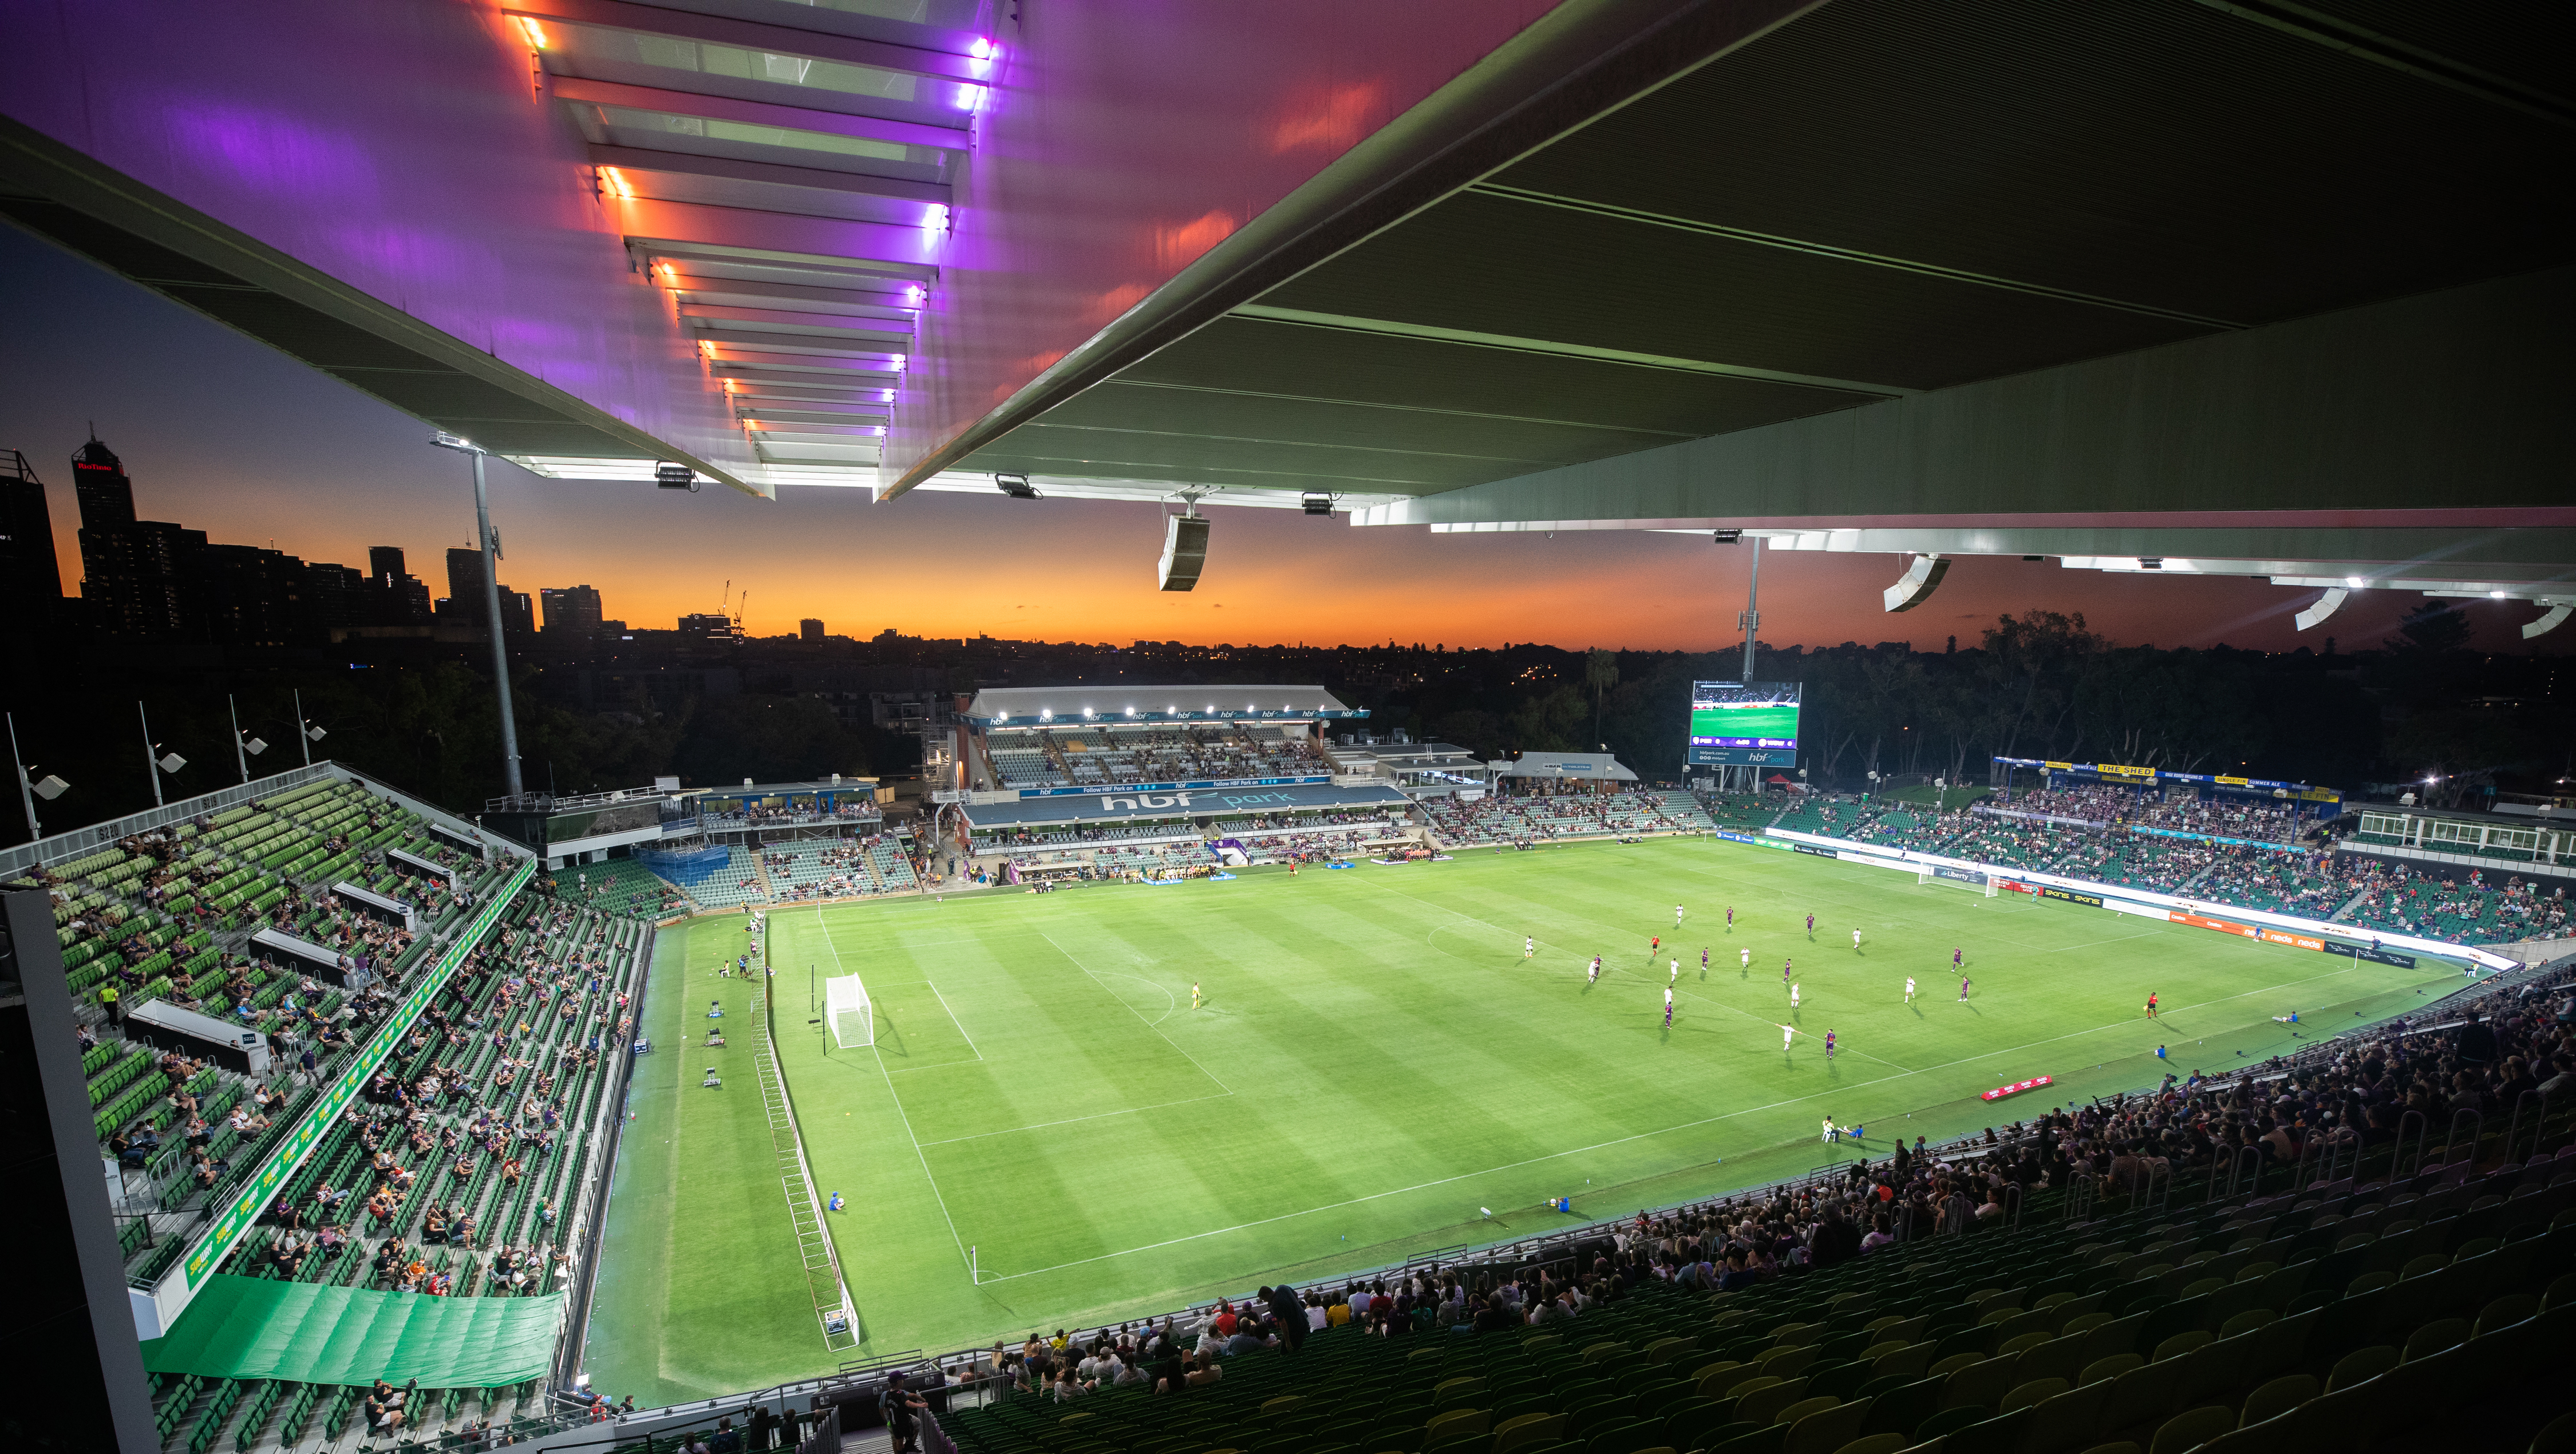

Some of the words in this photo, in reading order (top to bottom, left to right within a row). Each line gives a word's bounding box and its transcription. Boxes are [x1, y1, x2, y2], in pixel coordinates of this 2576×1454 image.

[1749, 753, 1769, 761] hbf
[2124, 767, 2151, 775] SHED
[203, 796, 217, 809] S219
[1101, 792, 1196, 811] hbf
[1222, 792, 1297, 807] park
[99, 824, 118, 840] S220
[1947, 870, 1969, 880] Liberty
[2270, 934, 2293, 943] neds
[2298, 939, 2321, 949] neds
[318, 1099, 332, 1121] SUBWAY
[301, 1119, 315, 1143] SUBWAY
[283, 1139, 299, 1164] SUBWAY
[263, 1160, 280, 1187] SUBWAY
[240, 1186, 259, 1216] SUBWAY
[216, 1212, 237, 1244] SUBWAY
[190, 1240, 212, 1276] SUBWAY
